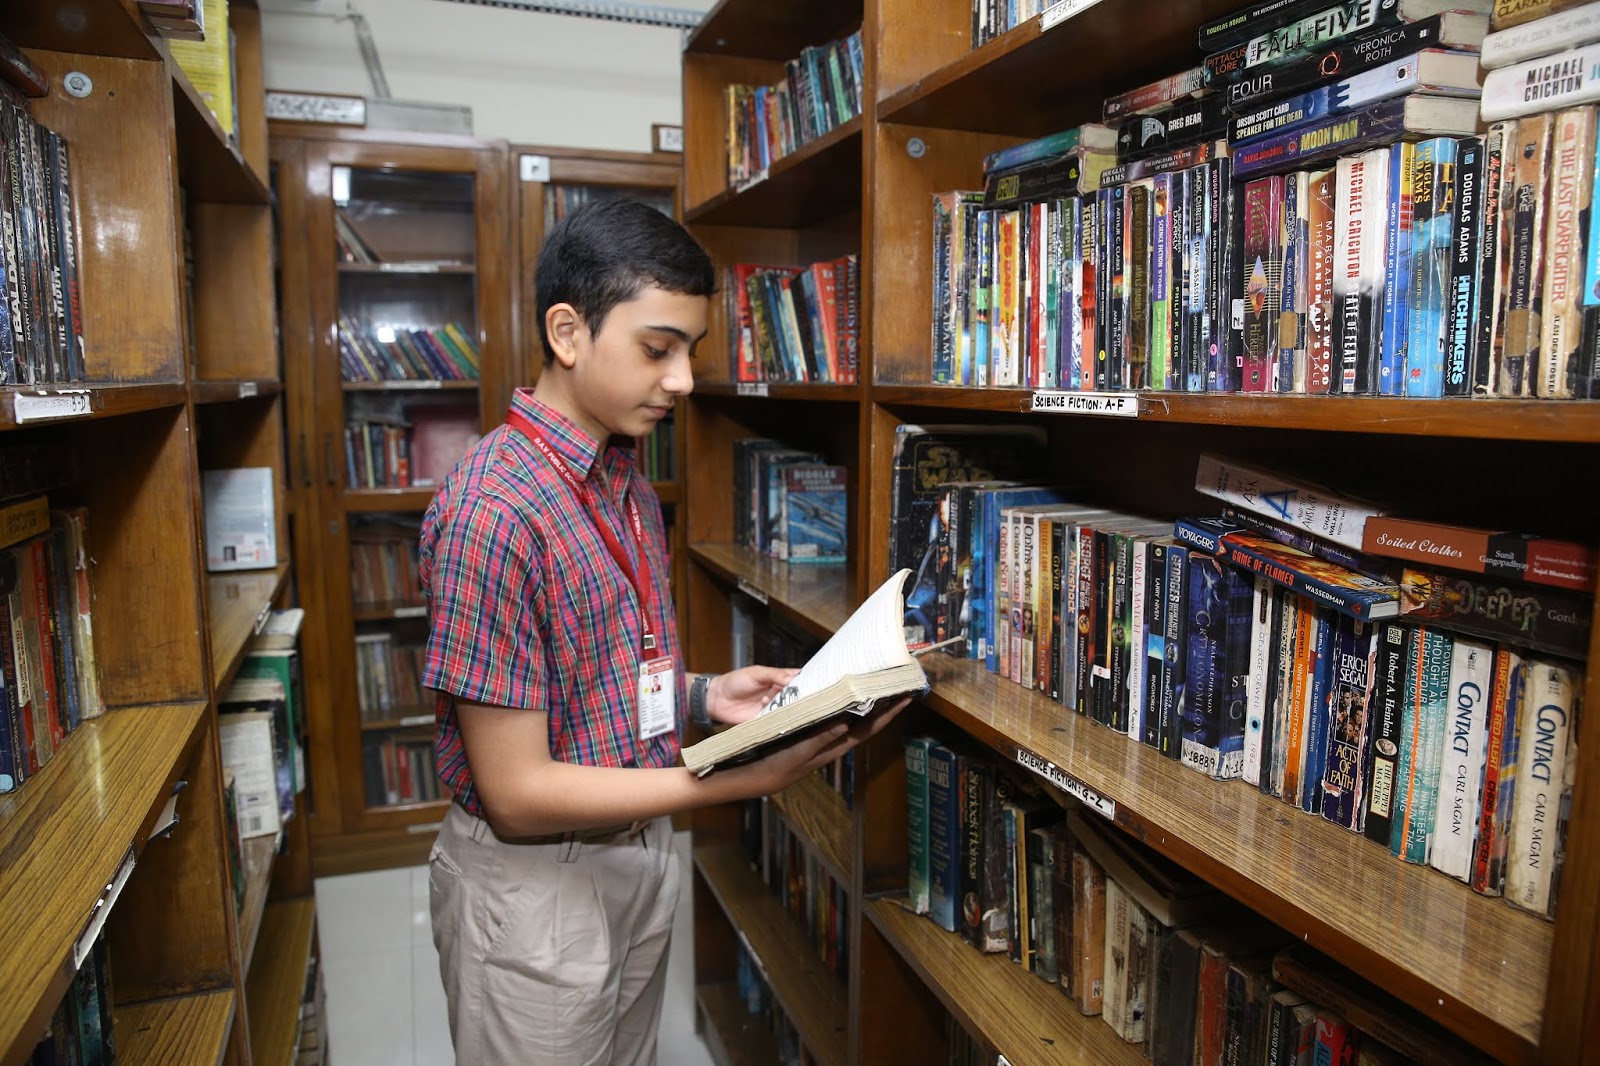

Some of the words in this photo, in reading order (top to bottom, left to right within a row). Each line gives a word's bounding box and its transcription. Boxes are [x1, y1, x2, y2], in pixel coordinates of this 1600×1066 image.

[1257, 30, 1306, 61] FALL
[1314, 0, 1371, 41] FIVE
[1353, 30, 1406, 55] VERONICA
[1207, 47, 1247, 69] PITTACUS
[1215, 61, 1238, 75] LORE
[1249, 42, 1257, 64] THE
[1365, 46, 1391, 63] ROTH
[1231, 74, 1272, 97] FOUR
[1526, 57, 1584, 86] MICHAEL
[1524, 75, 1583, 102] CRICHTON
[1168, 117, 1185, 132] GREG
[1185, 112, 1202, 127] BEAR
[1236, 113, 1256, 129] ORSON
[1255, 107, 1273, 123] SCOTT
[1273, 102, 1290, 117] CARD
[1236, 124, 1262, 140] SPEAKER
[1262, 119, 1275, 131] FOR
[1275, 114, 1287, 128] THE
[1287, 109, 1303, 125] DEAD
[1301, 126, 1331, 151] MOON
[1332, 118, 1359, 142] MAN
[58, 145, 70, 187] TOM
[1102, 166, 1126, 178] DOUGLAS
[1422, 146, 1432, 203] DOUGLAS
[1562, 147, 1577, 171] THE
[1102, 173, 1125, 185] ADAMS
[1195, 169, 1203, 193] JACK
[1348, 161, 1364, 216] MICHAEL
[1414, 148, 1425, 205] ADAMS
[1558, 176, 1575, 207] LAST
[1461, 172, 1474, 223] DOUGLAS
[61, 192, 76, 269] CLANCY
[1157, 219, 1165, 243] SCIENCE
[1195, 195, 1203, 234] CHRISTIE
[1082, 205, 1091, 262] XENOCIDE
[1346, 219, 1362, 279] CRICHTON
[1459, 226, 1471, 264] ADAMS
[3, 209, 24, 336] BALDACCI
[942, 233, 953, 306] DOUGLAS
[1323, 220, 1333, 305] MARGARET
[1551, 210, 1571, 304] STARFIGHTER
[20, 266, 30, 314] HIGGINS
[53, 264, 64, 319] WIDOW
[1313, 251, 1323, 349] HANDMAID'S
[1345, 282, 1359, 318] STATE
[1450, 275, 1458, 310] GUIDE
[59, 326, 67, 348] THE
[941, 310, 952, 362] ADAMS
[1346, 321, 1356, 331] OF
[1451, 274, 1471, 385] HITCHHIKER'S
[1249, 323, 1261, 368] HERBERT
[1321, 312, 1331, 386] ATWOOD
[1344, 335, 1357, 364] FEAR
[1312, 355, 1320, 386] TALE
[1446, 343, 1454, 384] GALAXY
[1034, 395, 1065, 408] SCIENCE
[1068, 397, 1103, 410] FICTION:
[1105, 398, 1125, 411] A-F
[548, 451, 567, 476] PUBLIC
[1242, 479, 1259, 505] ASK
[634, 514, 642, 536] PUBLIC
[1322, 504, 1333, 531] CHAOS
[1329, 503, 1341, 536] WALKING
[1178, 525, 1215, 551] VOYAGERS
[1376, 533, 1416, 550] Soiled
[1418, 539, 1463, 558] Clothes
[1080, 533, 1092, 581] GEORGE
[1231, 549, 1252, 568] GAME
[1253, 559, 1263, 571] OF
[1264, 563, 1295, 586] FLAMES
[1479, 554, 1530, 572] Gangopadhyay
[1495, 550, 1515, 560] Sunil
[1067, 549, 1077, 614] Aftershock
[1134, 553, 1143, 591] VIRAL
[1305, 583, 1345, 607] WASSERMAN
[1454, 580, 1542, 632] DEEPER
[1133, 592, 1141, 634] MATCH
[1298, 630, 1306, 659] ORWELL
[1430, 634, 1443, 688] THOUGHT
[1194, 609, 1211, 738] CRYPTONOMICON
[1339, 667, 1367, 689] SEGAL
[1341, 652, 1368, 673] ERICH
[1385, 651, 1399, 683] Robert
[1410, 629, 1421, 702] IMAGINATION
[1419, 631, 1431, 703] EIGHTY-FOUR
[1149, 674, 1157, 712] RINGWORLD
[1206, 662, 1216, 715] STEPHENSON
[1294, 663, 1303, 699] NINETEEN
[1385, 684, 1396, 696] A.
[1495, 650, 1510, 712] STARFORCE
[1162, 696, 1170, 727] HAWKING
[1382, 698, 1396, 737] Heinlein
[1408, 705, 1418, 731] WITH
[1428, 690, 1438, 714] AND
[1291, 700, 1301, 748] EIGHTY-FOUR
[1451, 681, 1482, 757] CONTACT
[1493, 713, 1503, 735] RED
[1336, 745, 1358, 764] ACTS
[1407, 734, 1416, 753] ITS
[1414, 707, 1427, 770] CONTINUES
[1489, 737, 1502, 771] ALERT
[1531, 703, 1567, 786] CONTACT
[1019, 751, 1048, 775] SCIENCE
[1050, 769, 1081, 794] FICTION:
[1082, 789, 1103, 810] G-Z
[1330, 769, 1355, 792] FAITH
[1339, 759, 1352, 775] OF
[1383, 763, 1392, 781] THE
[1413, 772, 1422, 786] TO
[1453, 764, 1467, 794] CARL
[1372, 766, 1382, 805] MASTERS
[1379, 781, 1391, 816] PUPPET
[1399, 755, 1413, 813] STARTLING
[1485, 780, 1497, 813] CHRIS
[1407, 788, 1420, 826] HAUNT
[1415, 790, 1430, 843] NINETEEN
[1451, 796, 1464, 836] SAGAN
[1532, 792, 1547, 824] CARL
[1404, 829, 1415, 851] THE
[1479, 815, 1493, 864] SPENCER
[1528, 827, 1544, 869] SAGAN
[1270, 1047, 1278, 1059] OF
[1271, 1026, 1279, 1048] MIND
